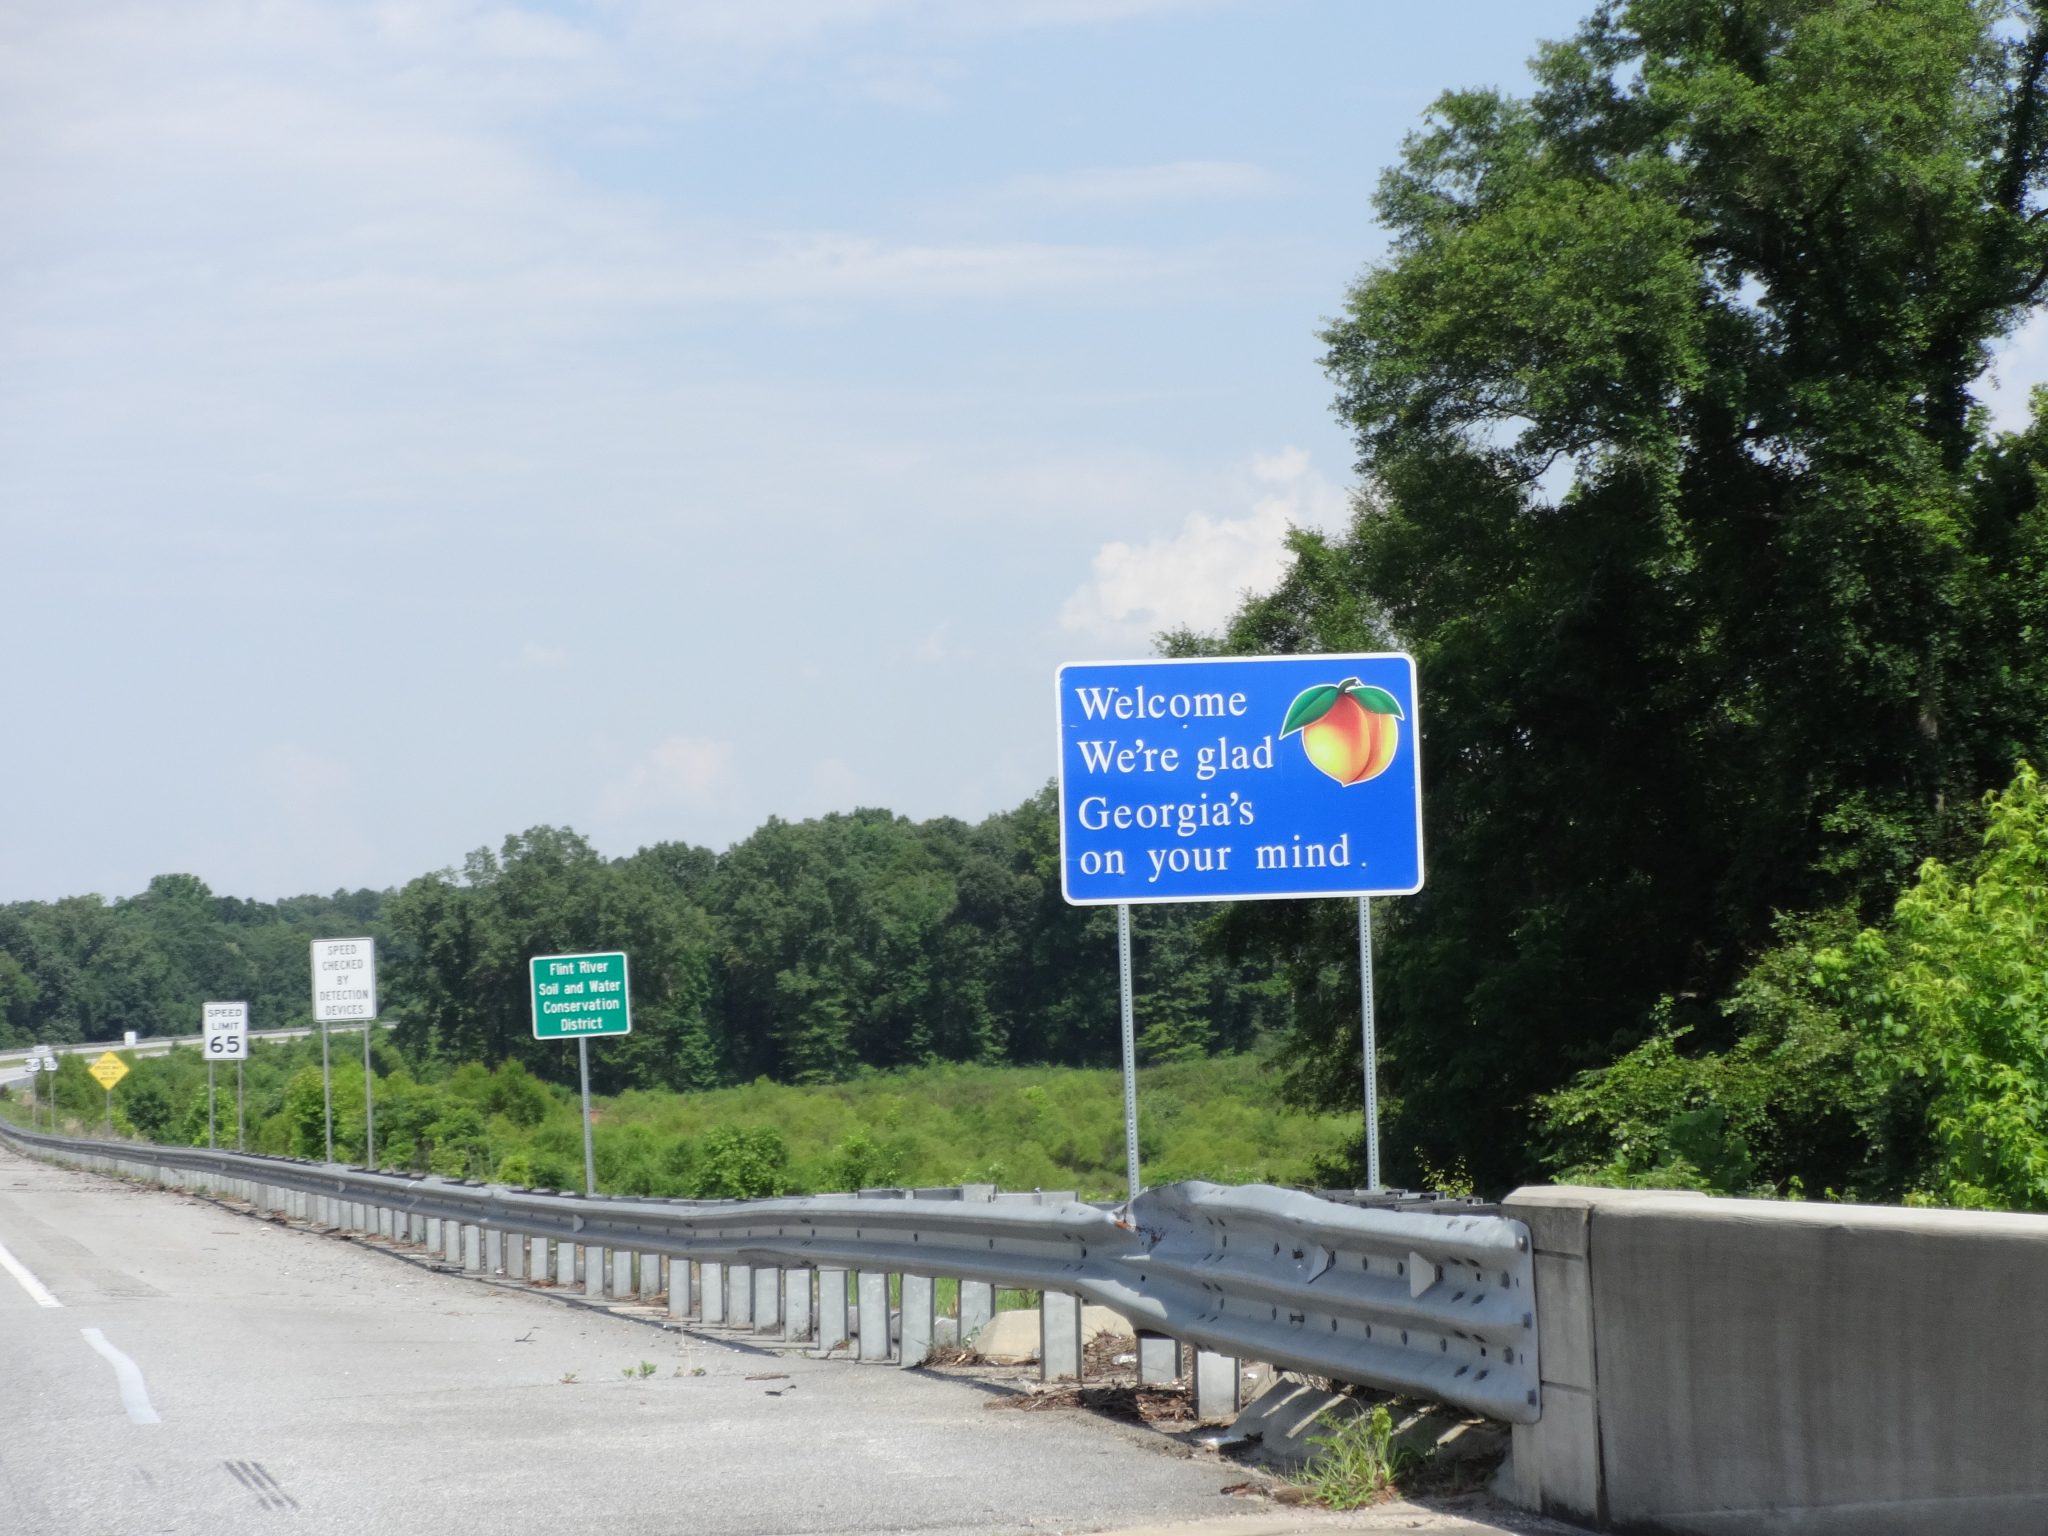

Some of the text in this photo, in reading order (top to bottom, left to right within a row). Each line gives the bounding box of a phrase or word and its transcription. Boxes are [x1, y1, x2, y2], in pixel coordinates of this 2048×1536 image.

[1075, 686, 1248, 720] Welcome
[1077, 736, 1274, 780] We're glad
[1078, 792, 1255, 837] Georgia's
[1080, 849, 1125, 874] on
[1148, 847, 1231, 883] your
[327, 944, 357, 955] SPEED
[322, 960, 363, 971] CHECKED
[549, 961, 608, 976] Flint River
[336, 975, 349, 985] BY
[538, 980, 621, 996] Soil and Water
[319, 990, 369, 1001] DETECTION
[325, 1004, 364, 1016] DEVICES
[543, 998, 620, 1014] Conservation
[208, 1009, 242, 1018] SPEED
[212, 1022, 239, 1030] LIMIT
[560, 1017, 603, 1031] District
[210, 1035, 240, 1053] 65
